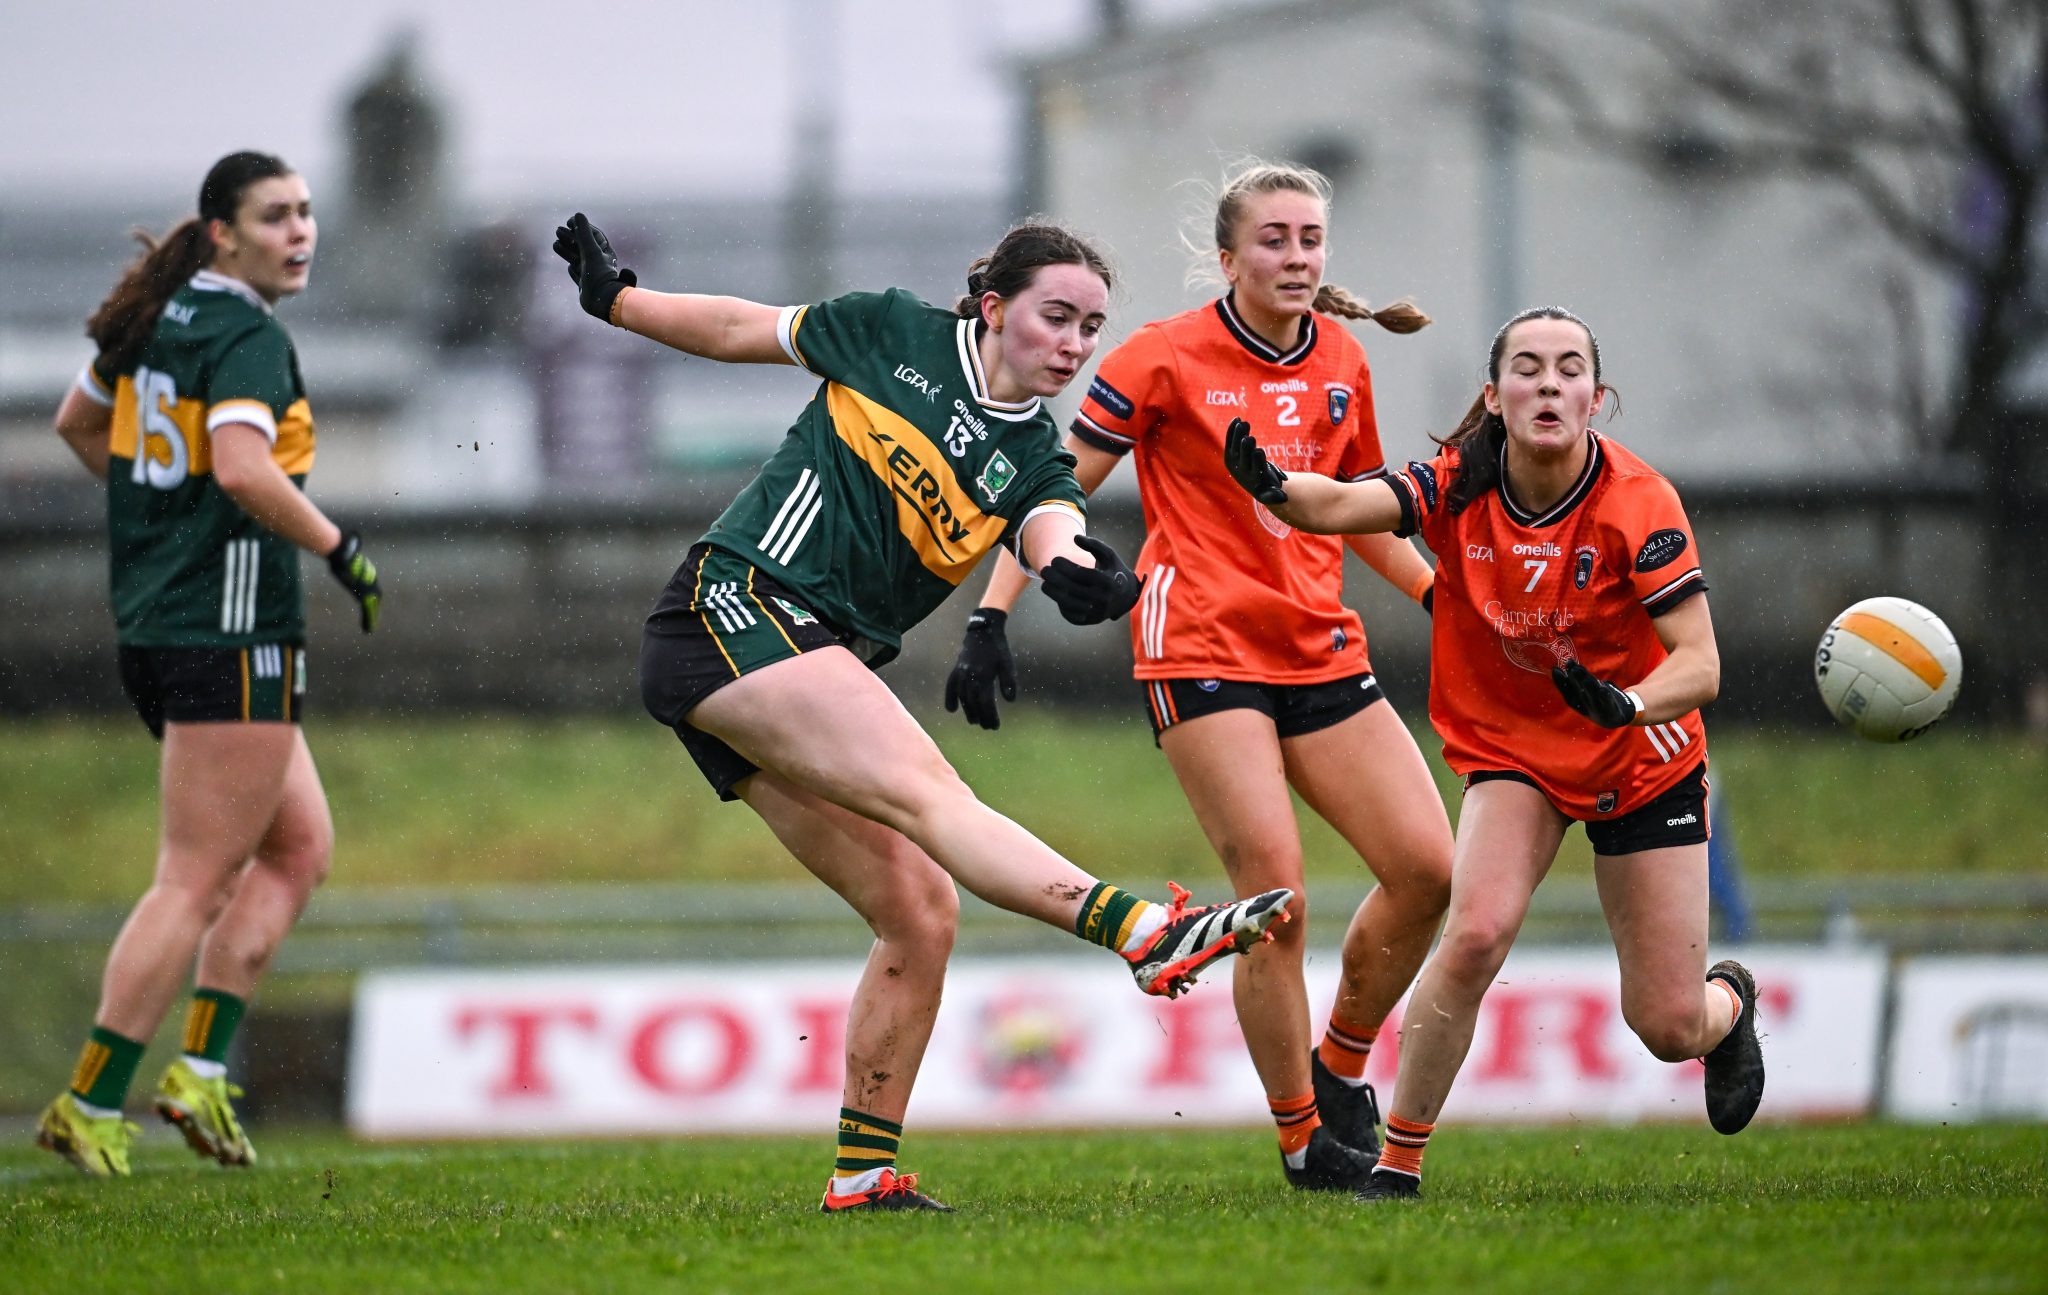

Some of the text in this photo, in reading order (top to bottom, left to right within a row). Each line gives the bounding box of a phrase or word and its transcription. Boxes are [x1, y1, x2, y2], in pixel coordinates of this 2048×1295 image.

[893, 363, 929, 395] LGFA
[1206, 390, 1239, 406] LGFA
[1275, 395, 1301, 426] 2
[131, 365, 189, 490] 15
[943, 416, 973, 458] 13
[1523, 559, 1548, 593] 7
